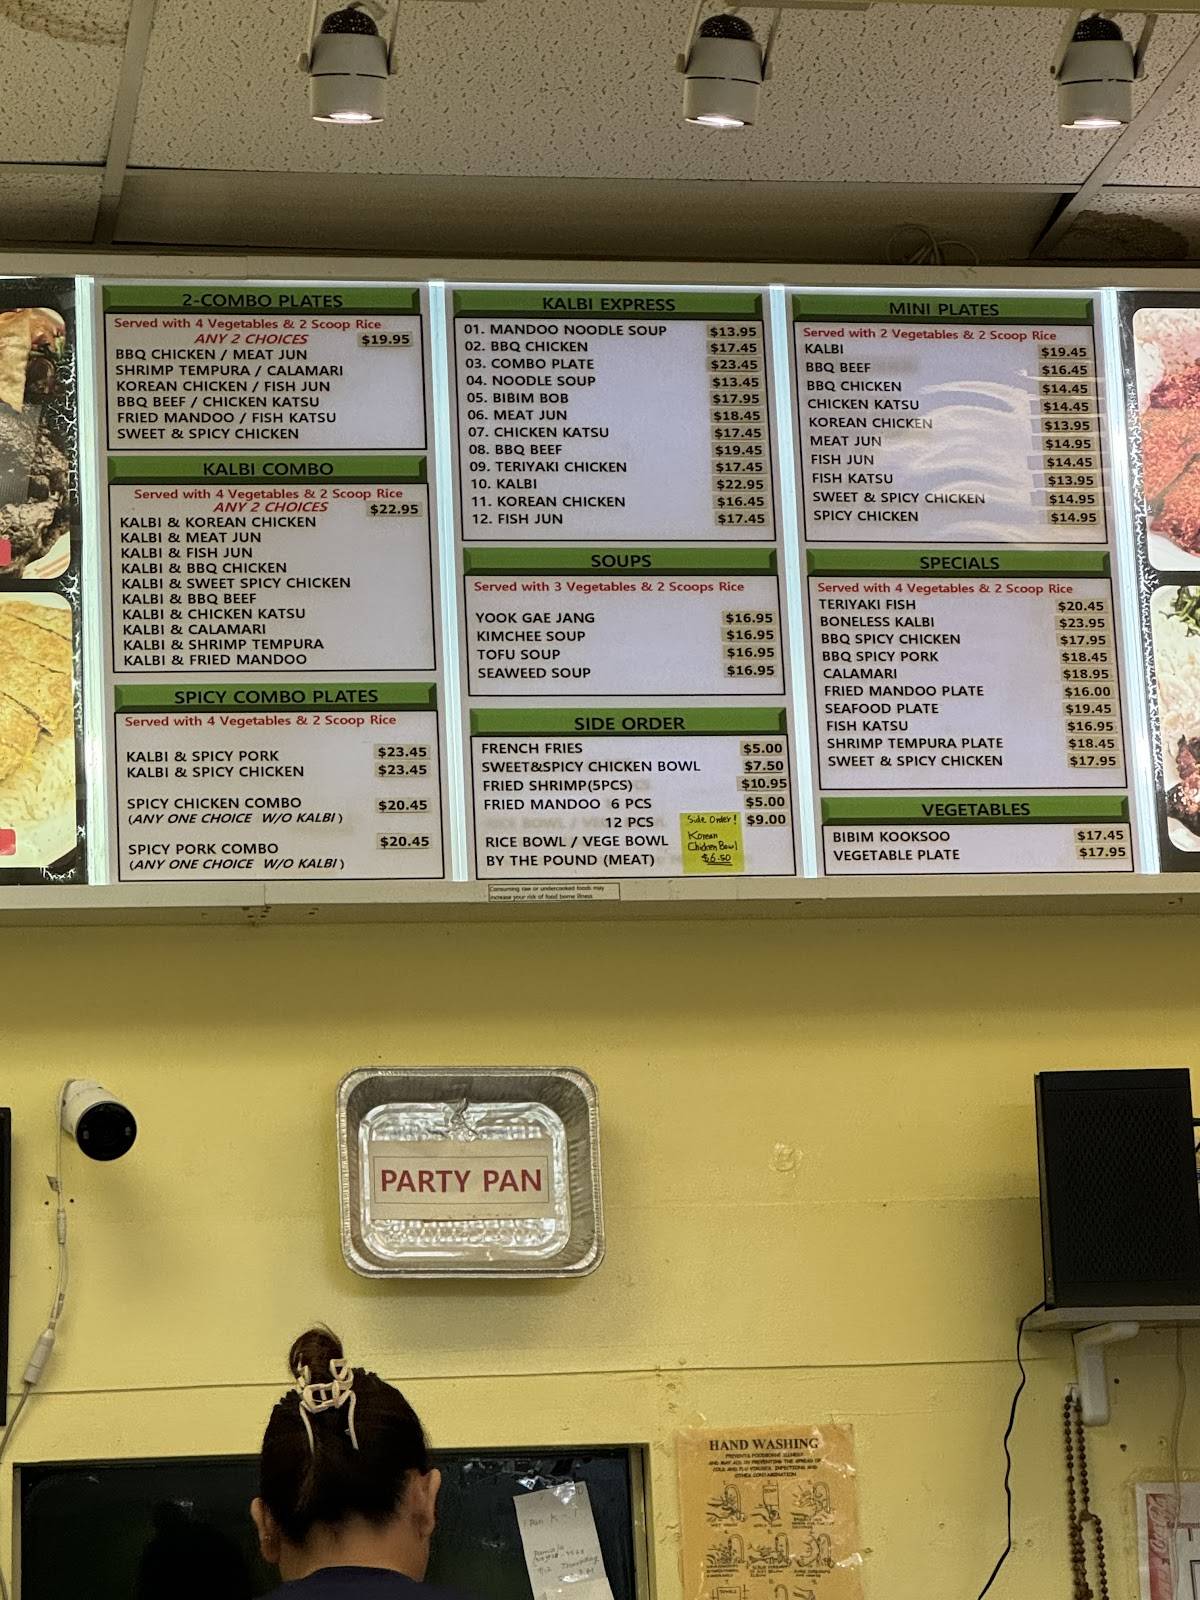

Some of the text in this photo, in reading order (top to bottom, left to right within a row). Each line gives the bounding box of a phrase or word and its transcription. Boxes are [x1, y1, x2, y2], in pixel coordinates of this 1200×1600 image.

[182, 294, 343, 308] 2-COMBO PLATES
[543, 297, 676, 311] KALBI EXPRESS
[889, 302, 999, 316] MINI PLATES
[114, 317, 381, 331] Served with 4 Vegetables & 2 Scoop Rice
[464, 323, 666, 336] 01. MANDOO NOODLE SOUP
[710, 326, 756, 338] $13.95
[361, 334, 409, 346] $19.95
[464, 341, 587, 352] 02. BBQ CHICKEN
[710, 342, 756, 355] $17.45
[804, 343, 843, 354] KALBI
[1041, 347, 1086, 359] $19.45
[465, 358, 594, 369] 03. COMBO PLATE
[711, 359, 757, 372] $23.45
[805, 361, 870, 373] BBQ BEEF
[115, 364, 342, 377] SHRIMP TEMPURA / CALAMARI
[1041, 365, 1087, 377] $16.45
[466, 392, 568, 403] 05. BIBIM BOB
[712, 393, 759, 406] $17.95
[117, 428, 298, 439] SWEET & SPICY CHICKEN
[203, 462, 334, 475] KALBI COMBO
[469, 461, 626, 472] 09. TERIYAKI CHICKEN
[715, 462, 762, 474] $17.45
[812, 472, 892, 484] FISH KATSU
[1048, 475, 1093, 488] $13.95
[370, 503, 418, 516] $22.95
[813, 510, 918, 521] SPICY CHICKEN
[120, 516, 315, 528] KALBI & KOREAN CHICKEN
[472, 513, 562, 524] 12. FISH JUN
[717, 513, 764, 525] $17.45
[1051, 512, 1096, 525] $14.95
[591, 554, 652, 567] SOUPS
[919, 556, 999, 569] SPECIALS
[818, 598, 915, 610] TERIYAKI FISH
[1058, 601, 1103, 612] $20.45
[475, 612, 594, 623] YOOK GAE JANG
[725, 612, 772, 624] $16.95
[820, 616, 934, 627] BONELESS KALBI
[1059, 618, 1104, 630] $23.95
[124, 654, 306, 665] KALBI & FRIED MANDOO
[478, 667, 590, 678] SEAWEED SOUP
[727, 664, 774, 677] $16.95
[823, 668, 896, 679] CALAMARI
[1063, 669, 1108, 681] $18.95
[174, 689, 378, 704] SPICY COMBO PLATES
[825, 703, 938, 713] SEAFOOD PLATE
[1065, 703, 1111, 716] $19.45
[574, 716, 685, 730] SIDE ORDER
[481, 742, 582, 754] FRENCH FRIES
[827, 737, 1003, 748] SHRIMP TEMPURA PLATE
[1068, 738, 1114, 750] $18.45
[378, 746, 426, 758] $23.45
[743, 743, 782, 755] $5.00
[126, 750, 278, 762] KALBI & SPICY PORK
[482, 760, 700, 772] SWEET&SPICY CHICKEN BOWL
[744, 760, 784, 772] $7.50
[921, 802, 1031, 816] VEGETABLES
[688, 815, 706, 823] Side
[746, 814, 785, 826] $9.00
[688, 830, 718, 840] Korean
[833, 831, 949, 842] BIBIM KOOKSOO
[1077, 830, 1123, 841] $17.45
[380, 835, 429, 849] $20.45
[688, 840, 737, 851] Chicken Bowl
[128, 843, 278, 855] SPICY PORK COMBO
[833, 849, 960, 861] VEGETABLE PLATE
[1079, 846, 1125, 859] $17.95
[486, 854, 654, 867] BY THE POUND (MEAT)
[381, 1169, 541, 1192] PARTY PAN
[709, 1437, 818, 1450] HAND WASHING
